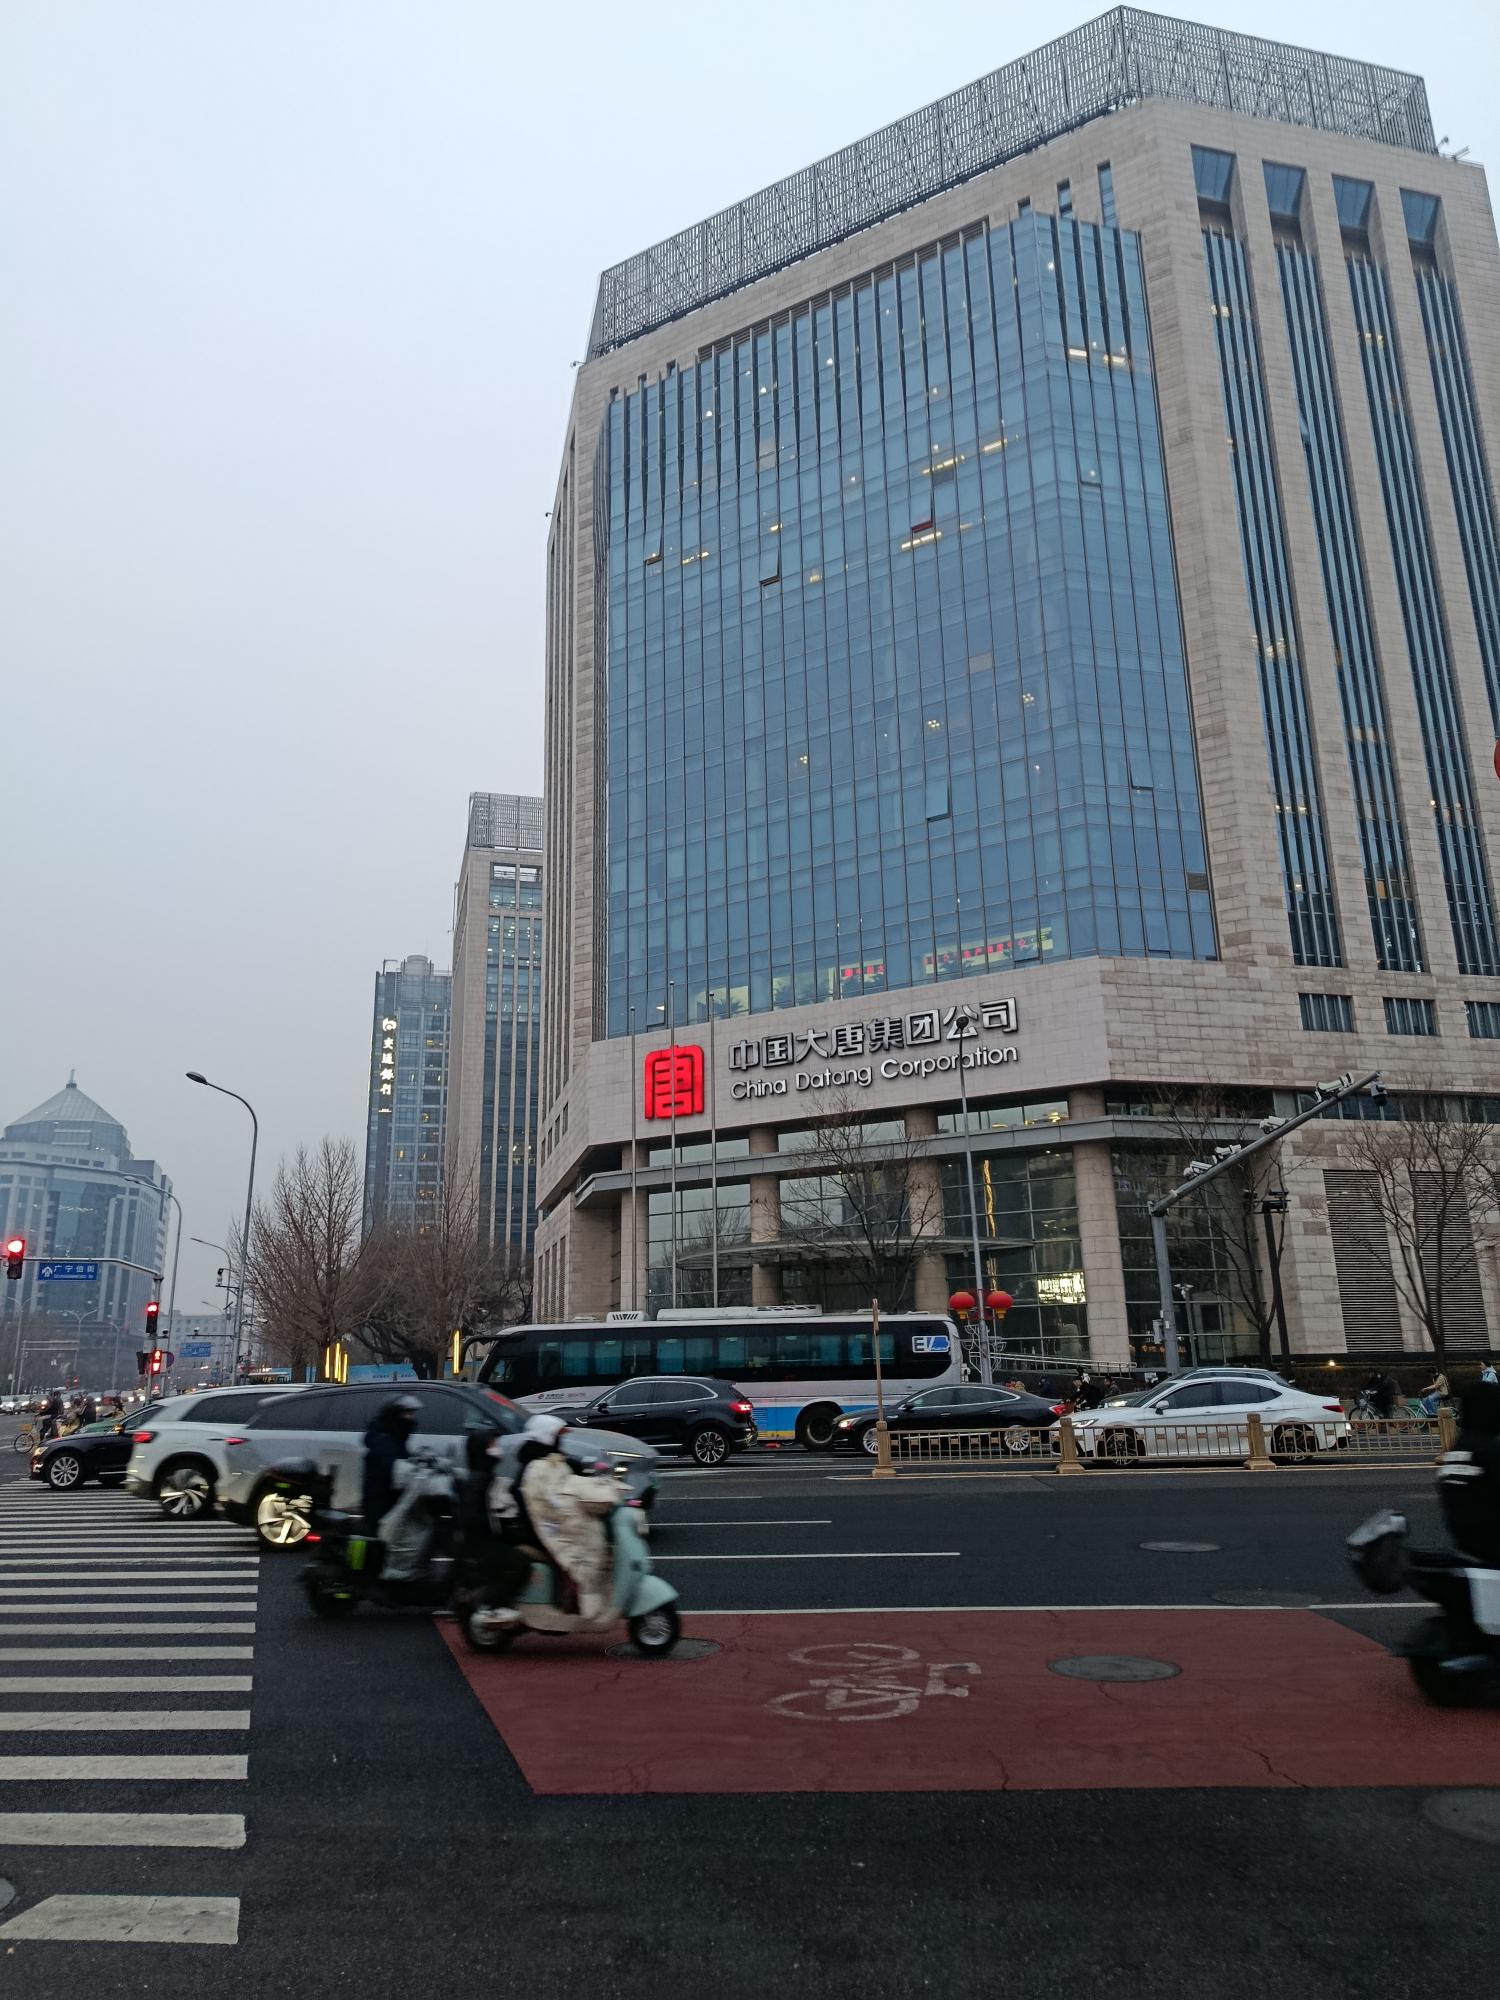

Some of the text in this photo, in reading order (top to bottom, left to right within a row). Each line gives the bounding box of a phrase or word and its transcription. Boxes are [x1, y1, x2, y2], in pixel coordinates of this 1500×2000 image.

[728, 997, 1018, 1070] 中国大唐集团公司
[730, 1046, 1018, 1099] China Datang Corporation
